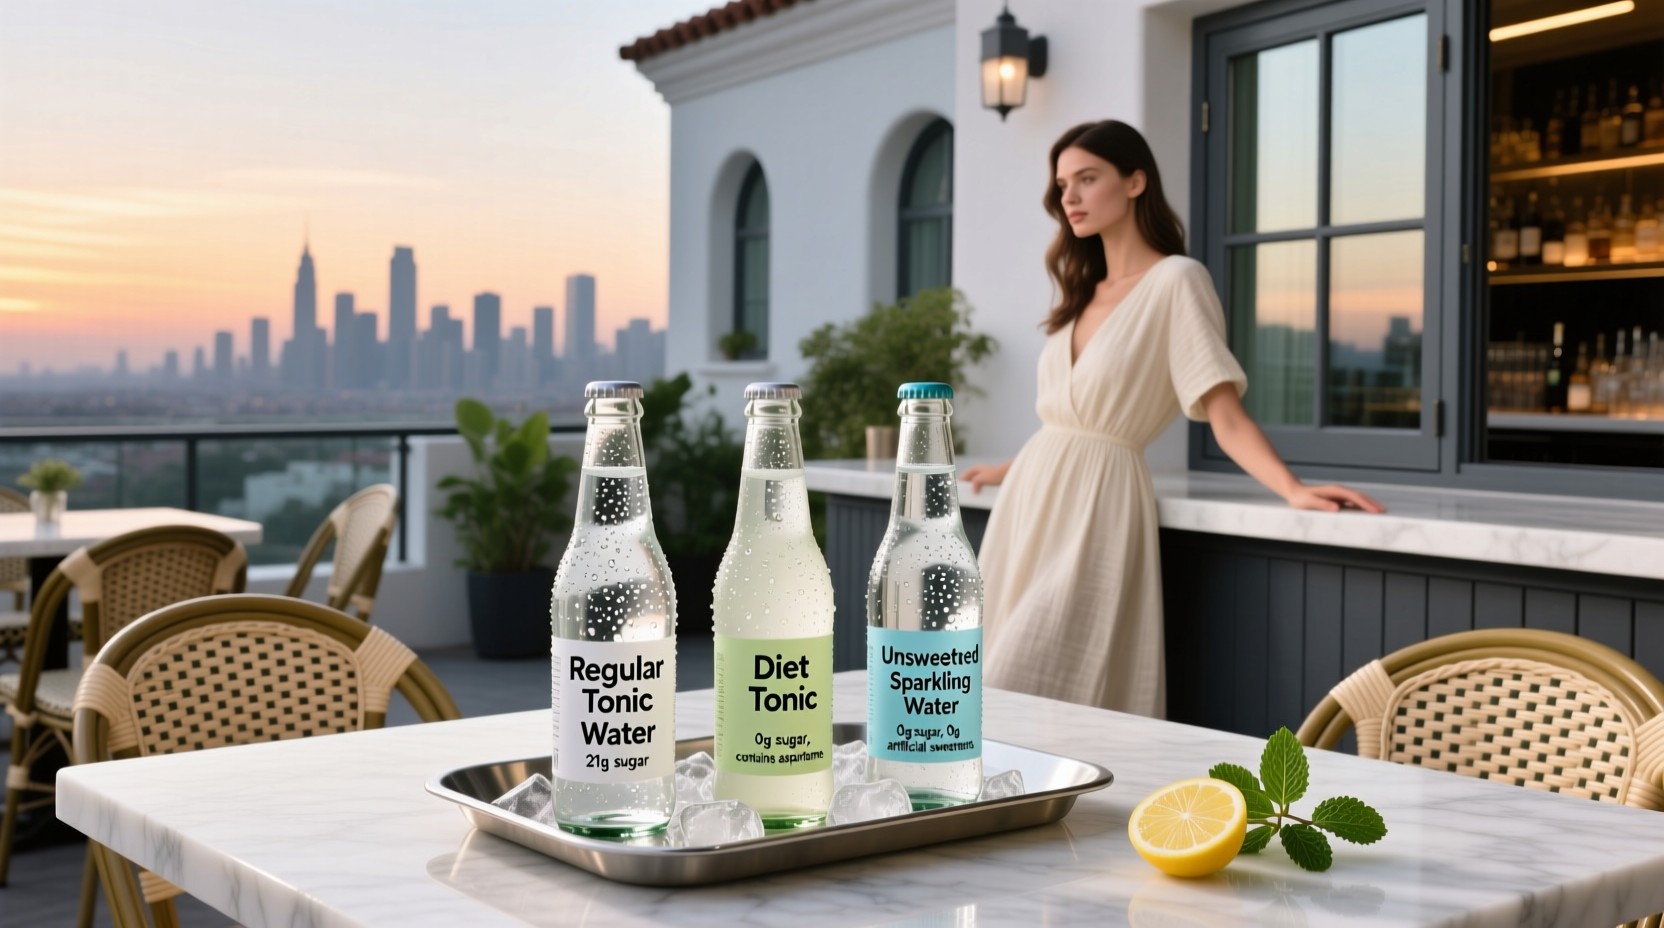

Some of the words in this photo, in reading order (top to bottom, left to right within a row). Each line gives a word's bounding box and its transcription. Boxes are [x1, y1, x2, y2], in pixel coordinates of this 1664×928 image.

[570, 655, 664, 689] Regular
[754, 654, 810, 680] Diet
[890, 671, 971, 695] Sparkling
[582, 687, 653, 713] Tonic
[748, 685, 818, 712] Tonic
[903, 696, 959, 715] Water
[581, 721, 656, 745] Water
[755, 732, 772, 749] 0g
[775, 734, 811, 749] sugar,
[897, 724, 912, 740] 0g
[947, 724, 960, 739] 0g
[586, 754, 609, 772] 21g
[614, 756, 649, 771] sugar
